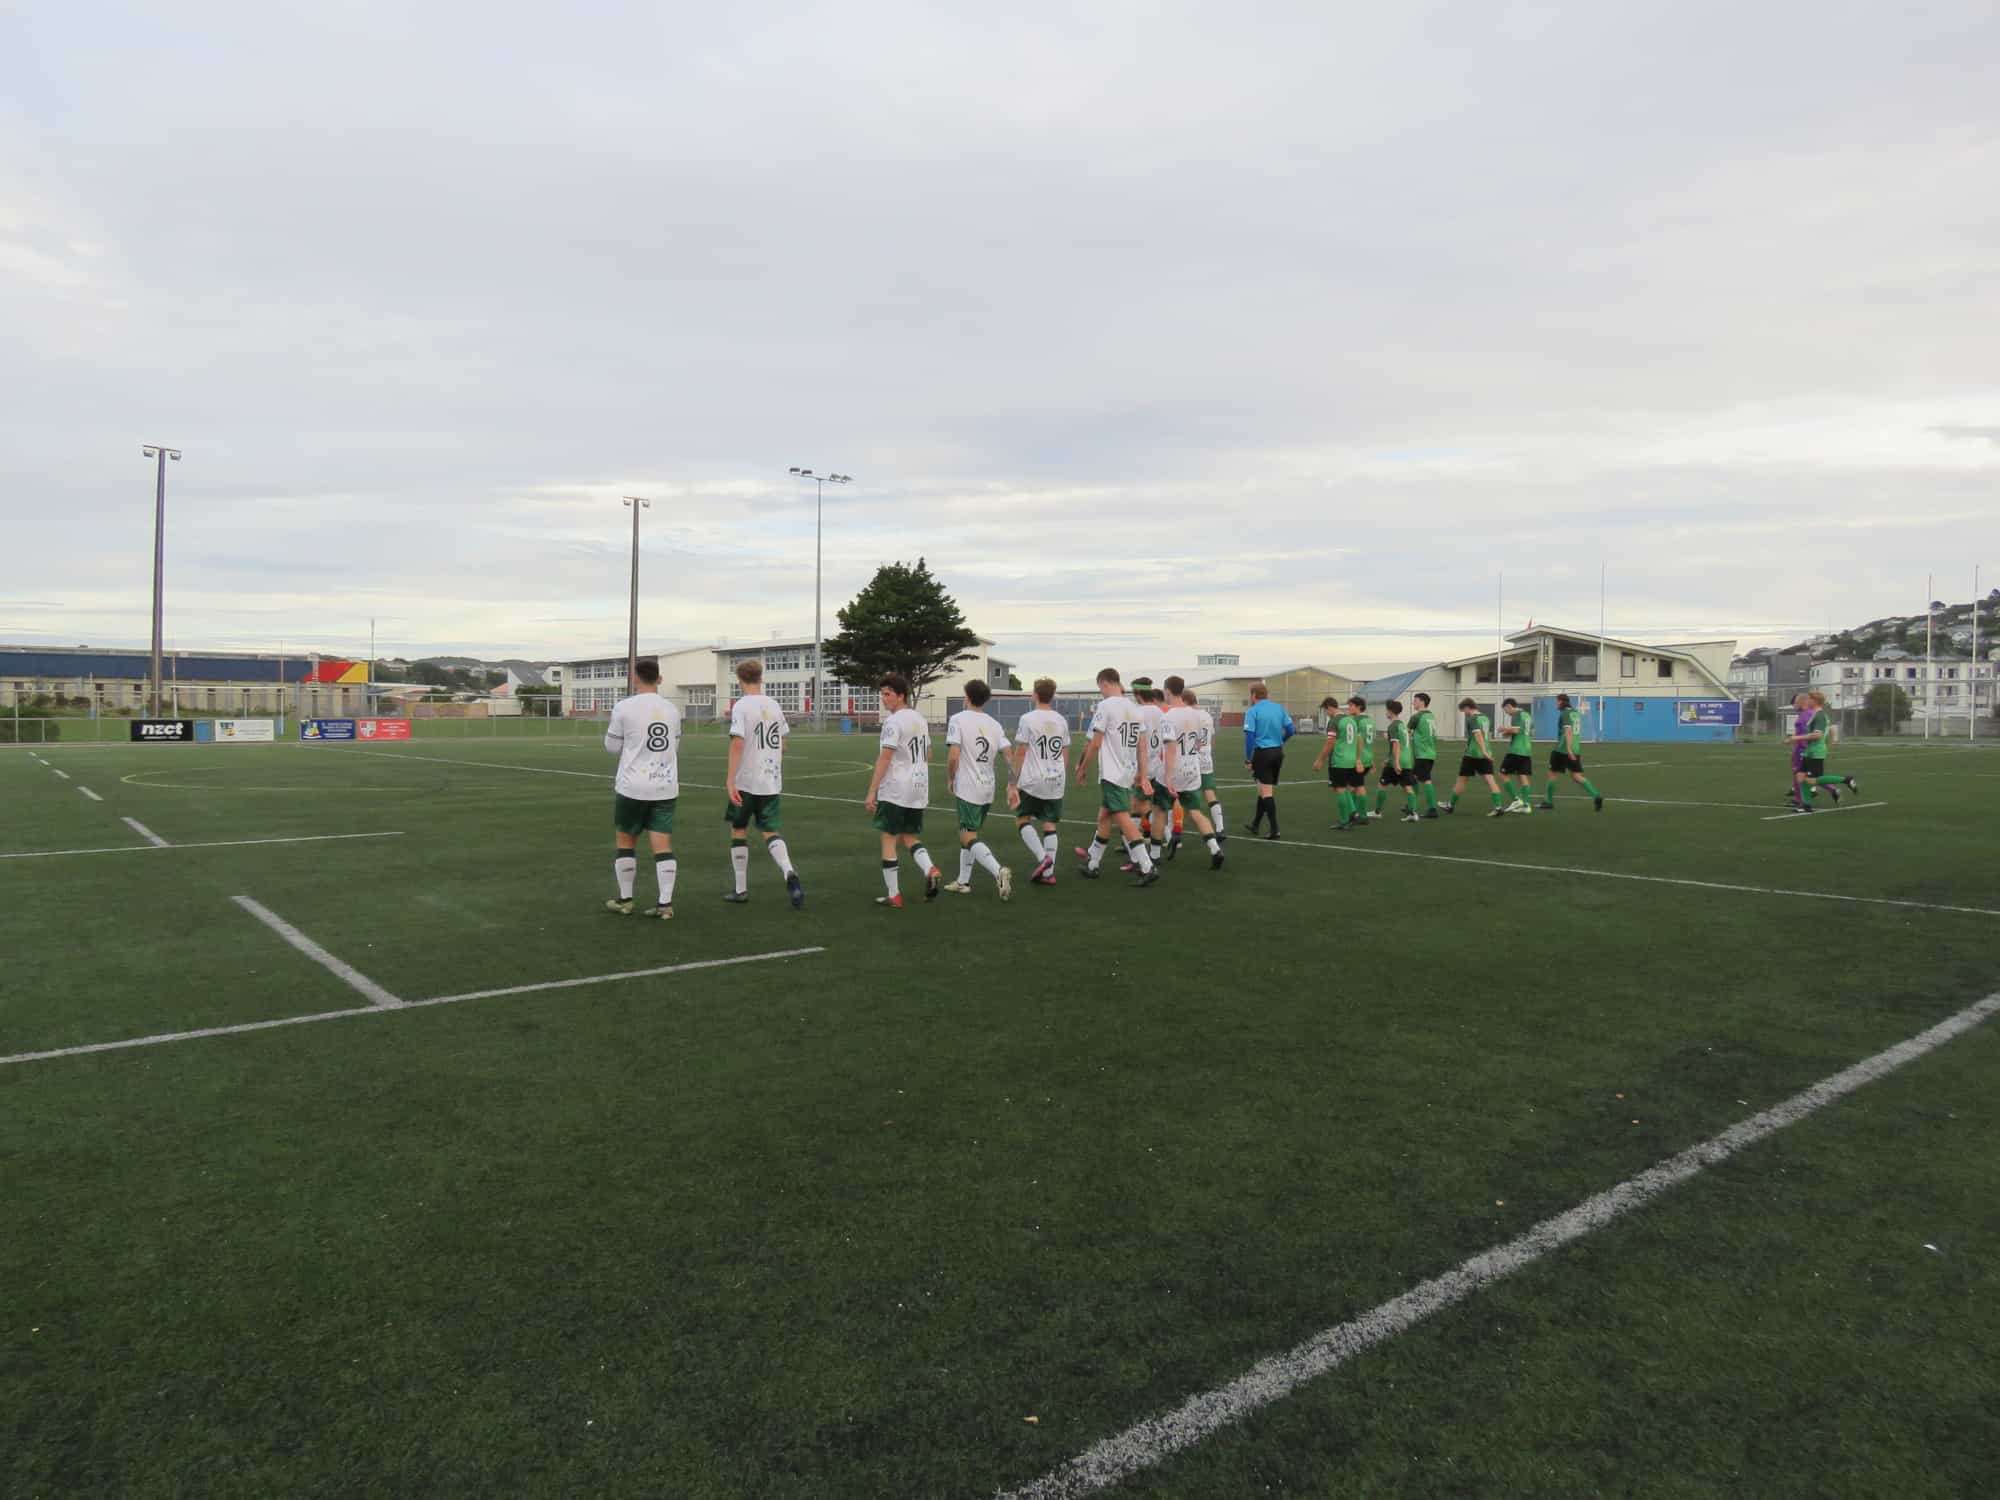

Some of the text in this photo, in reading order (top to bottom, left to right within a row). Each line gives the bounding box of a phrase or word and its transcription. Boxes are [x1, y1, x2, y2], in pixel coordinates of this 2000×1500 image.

[141, 722, 184, 735] nzct
[646, 721, 669, 752] 8
[754, 721, 780, 750] 16
[1117, 721, 1140, 748] 15
[1366, 724, 1374, 745] 5
[907, 734, 928, 764] 11
[975, 736, 990, 763] 2
[1035, 734, 1063, 761] 19
[1176, 731, 1198, 756] 12
